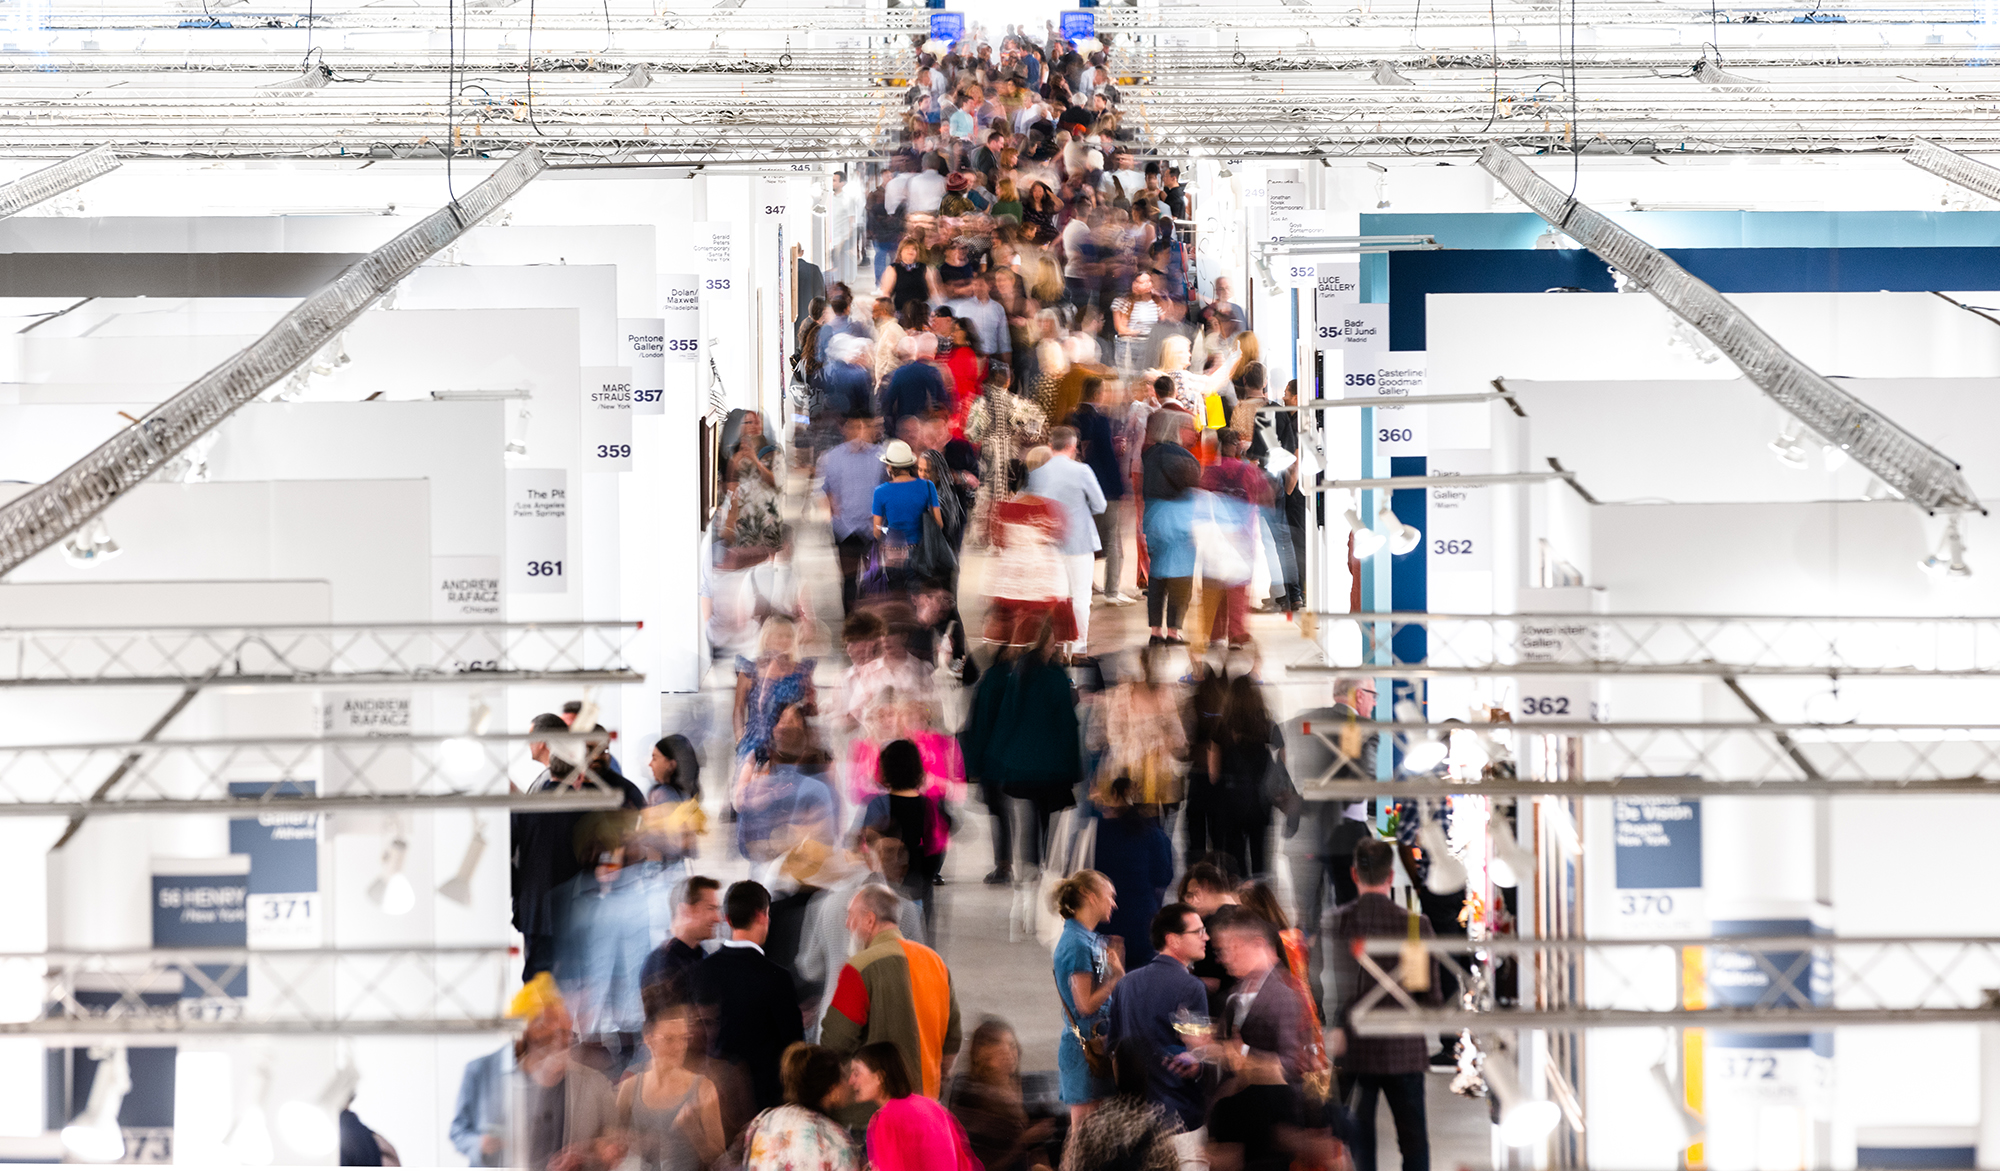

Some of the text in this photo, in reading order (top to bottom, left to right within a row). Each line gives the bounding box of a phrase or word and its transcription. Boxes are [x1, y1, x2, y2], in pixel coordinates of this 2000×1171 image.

[765, 205, 786, 215] 347
[1290, 267, 1315, 277] 352
[706, 279, 730, 290] 353
[1318, 276, 1340, 284] LUCE
[671, 288, 699, 297] Dolan/
[1318, 283, 1356, 292] GALLERY
[666, 296, 699, 304] Maxwell
[1344, 319, 1364, 328] Badr
[1344, 327, 1377, 336] El Jundi
[628, 334, 664, 342] Pontone
[633, 342, 664, 352] Gallery
[669, 339, 699, 351] 355
[638, 351, 664, 359] /London
[1377, 368, 1424, 378] Casterline
[1345, 373, 1377, 387] 356
[1377, 377, 1423, 387] Goodman
[602, 383, 631, 393] MARC
[1377, 386, 1411, 397] Gallery
[591, 393, 631, 402] STRAUS
[633, 389, 664, 403] 357
[1378, 428, 1413, 443] 360
[597, 444, 632, 459] 359
[526, 488, 566, 500] The Pit
[1432, 489, 1468, 502] Gallery
[534, 501, 566, 510] Angeles
[513, 509, 566, 519] Palm Springs
[1434, 539, 1474, 555] 362
[526, 560, 563, 577] 361
[441, 578, 500, 591] ANDREW
[447, 591, 499, 603] RAFACZ
[343, 698, 411, 713] ANDREW
[1522, 696, 1571, 716] 362
[350, 711, 411, 726] RAFACZ
[182, 886, 247, 908] HENRY
[263, 899, 311, 920] 371
[1620, 894, 1674, 915] 370
[1720, 1056, 1778, 1079] 372
[122, 1135, 171, 1161] 73
